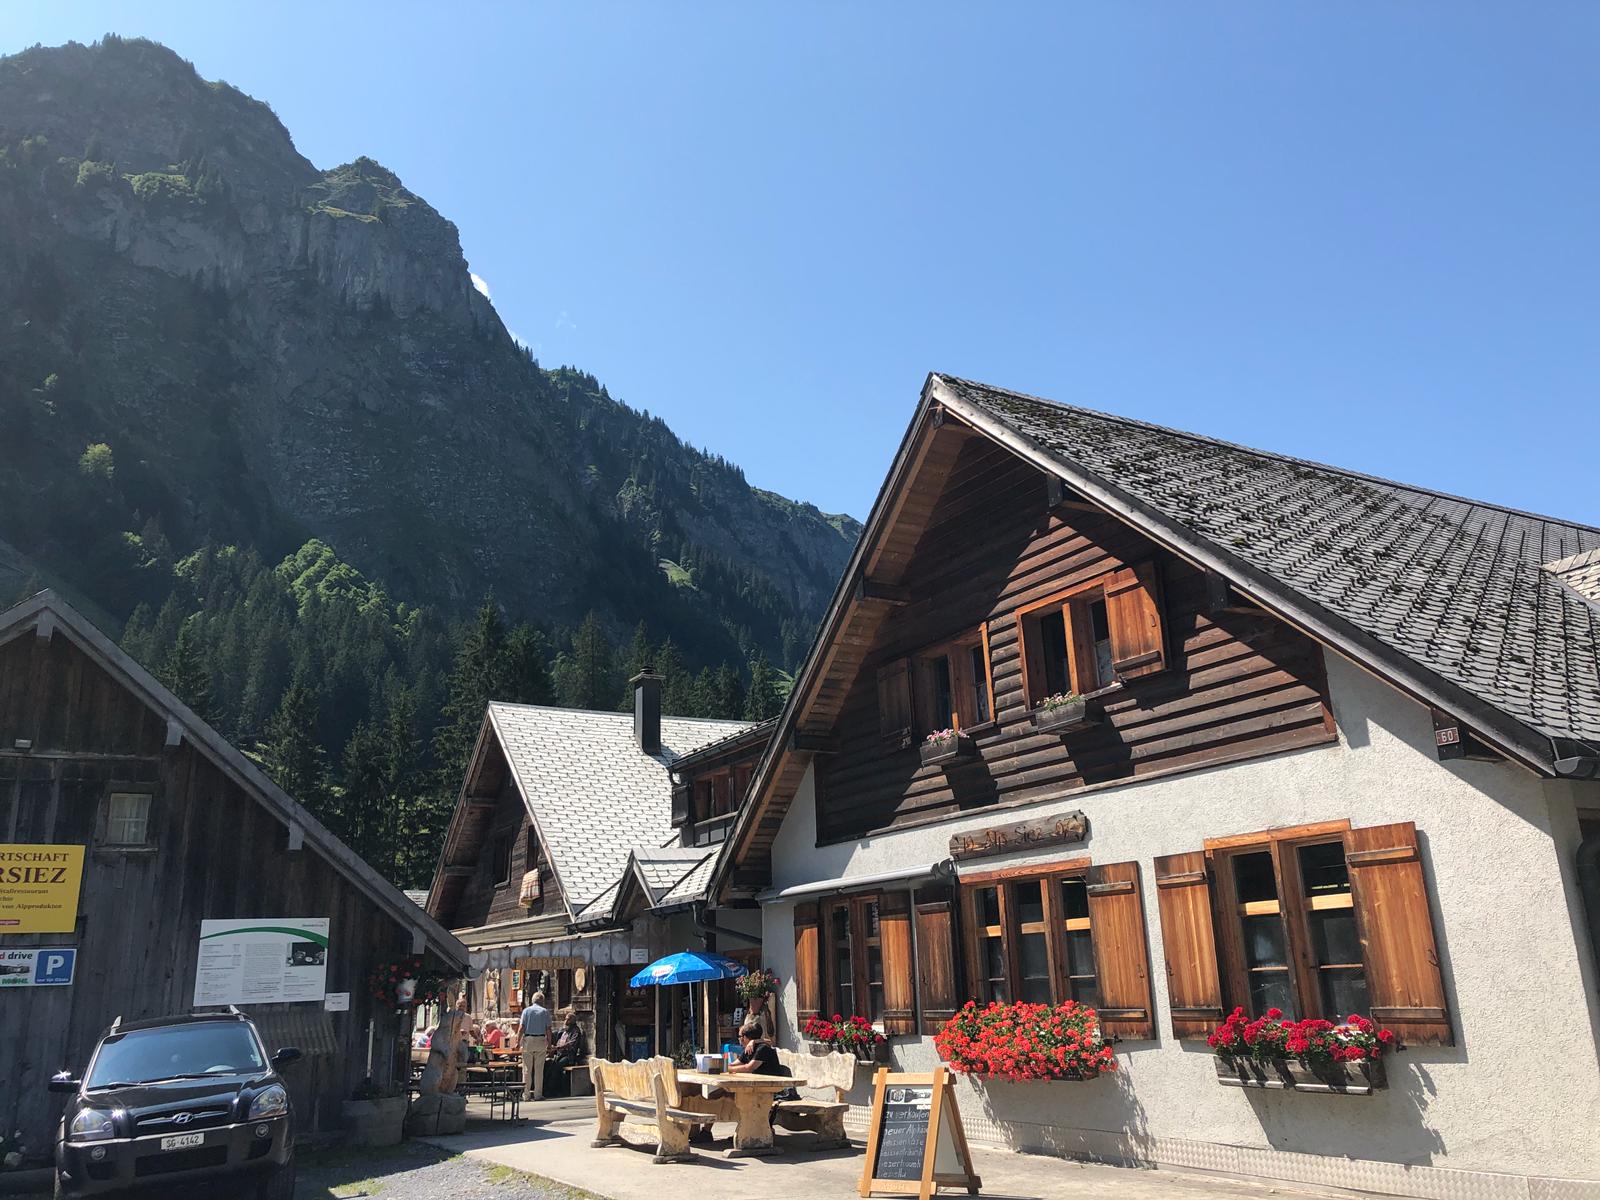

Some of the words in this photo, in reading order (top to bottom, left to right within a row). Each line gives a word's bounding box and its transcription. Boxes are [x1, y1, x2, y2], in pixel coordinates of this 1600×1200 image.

[1441, 730, 1454, 742] 60
[1014, 825, 1042, 846] Siez
[8, 951, 33, 960] drive
[46, 955, 65, 976] P
[166, 1139, 176, 1148] SG
[180, 1135, 199, 1146] 4142
